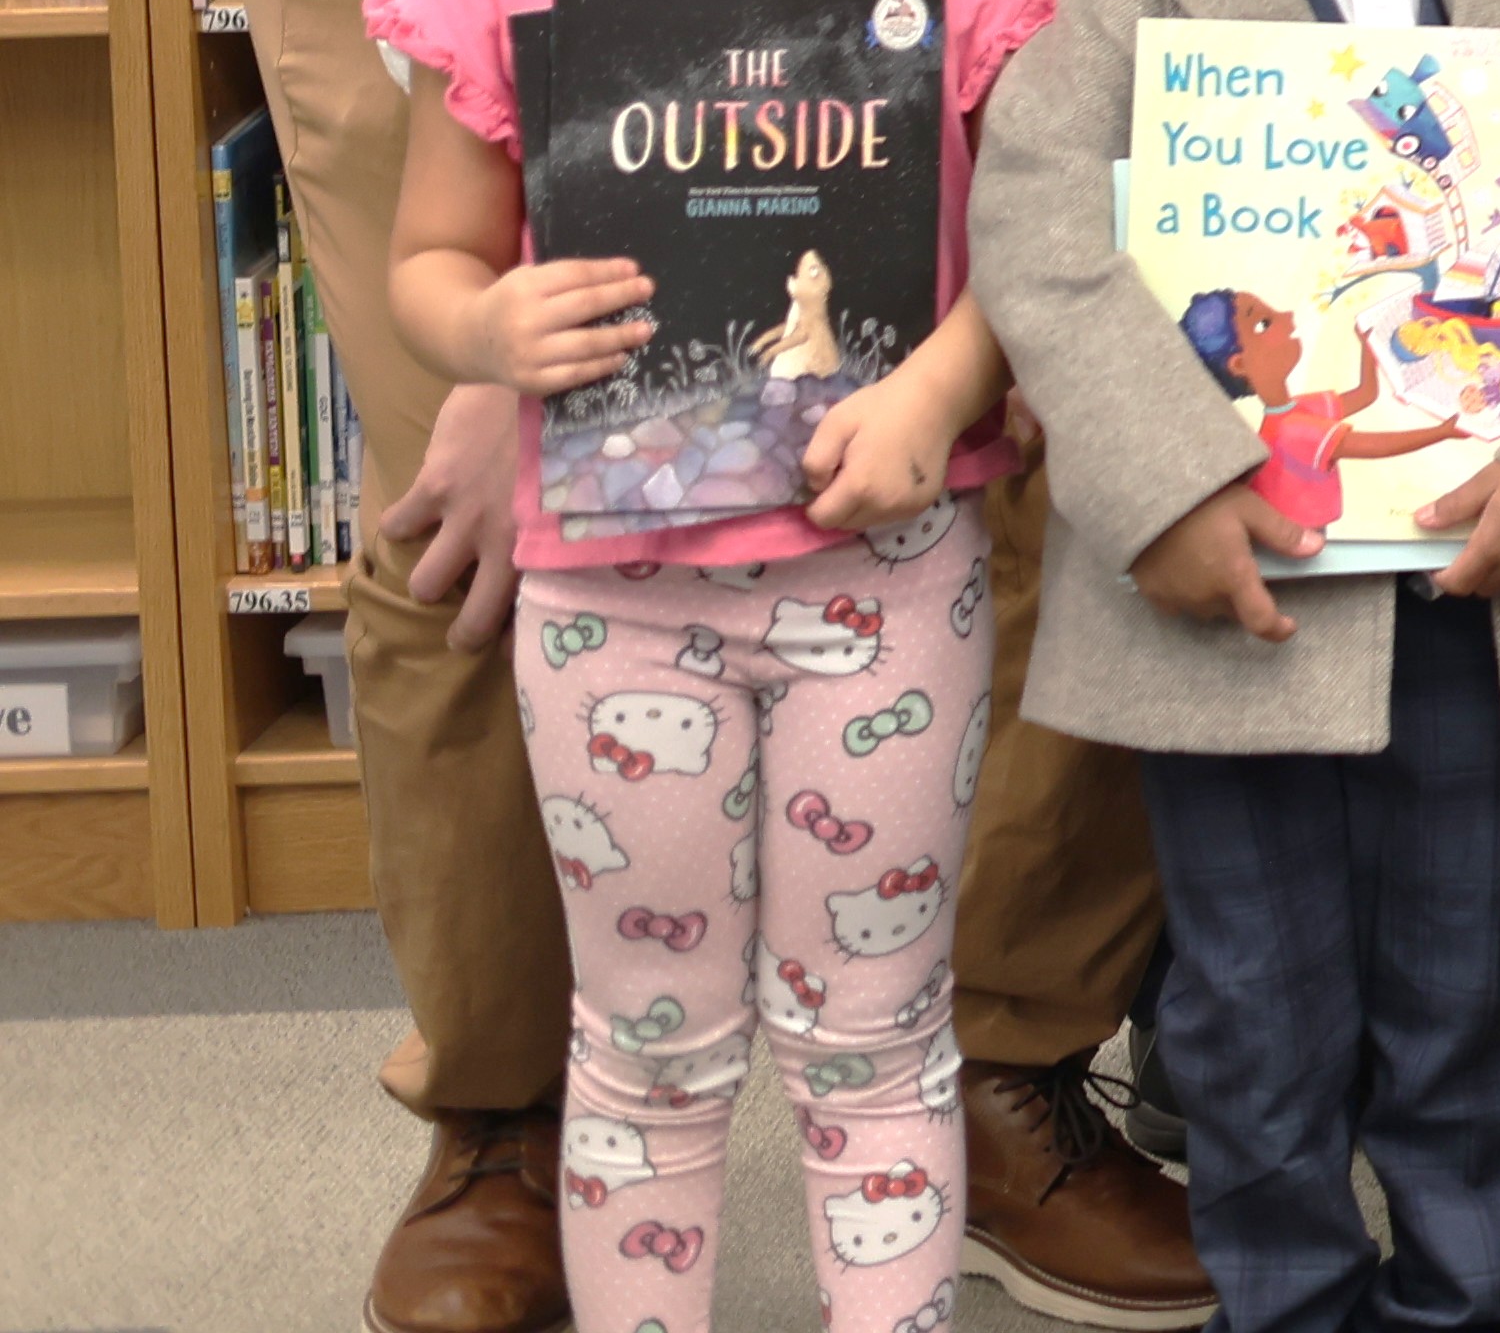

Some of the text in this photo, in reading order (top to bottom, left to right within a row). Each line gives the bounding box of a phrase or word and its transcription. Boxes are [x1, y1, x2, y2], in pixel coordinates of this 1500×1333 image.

[724, 48, 791, 88] THE
[1163, 51, 1285, 98] When
[611, 98, 891, 174] OUTSIDE
[1162, 121, 1370, 171] You Love
[686, 194, 821, 219] GIANNA MARINO
[1155, 192, 1323, 240] a Book
[229, 589, 309, 612] 796.35
